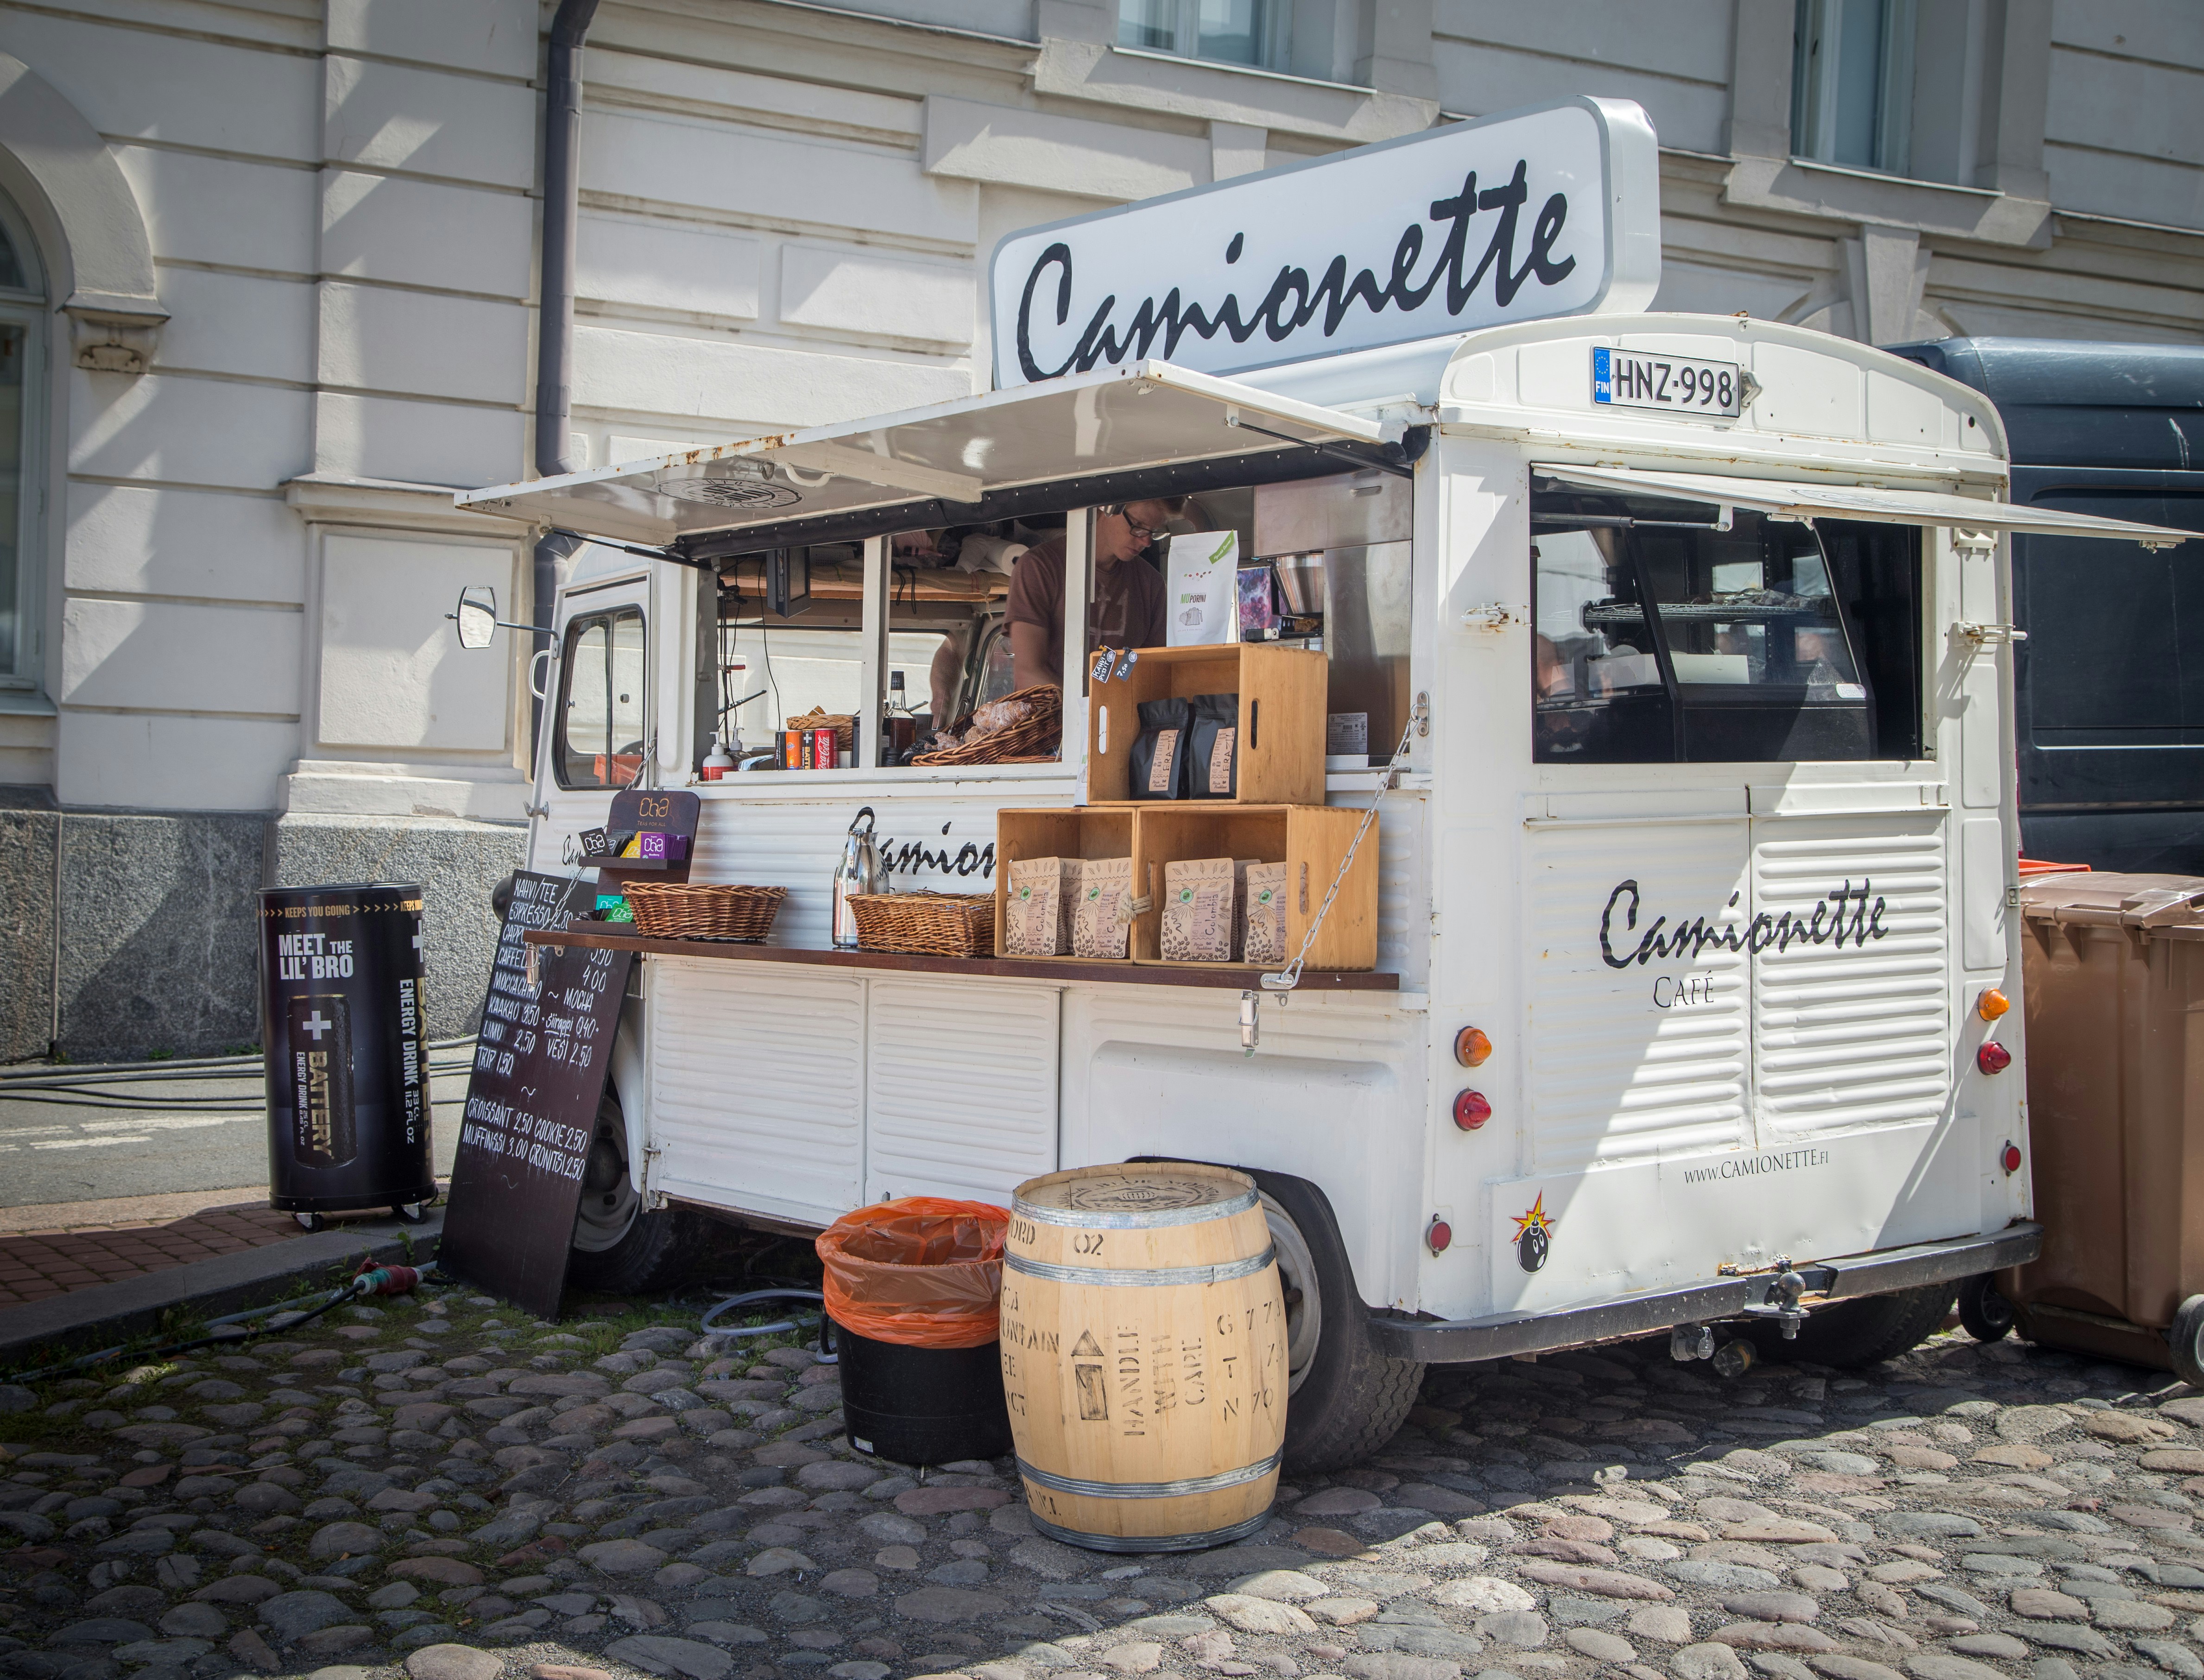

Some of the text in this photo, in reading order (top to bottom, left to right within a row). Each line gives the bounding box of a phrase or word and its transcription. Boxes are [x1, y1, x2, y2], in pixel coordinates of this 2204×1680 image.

[1017, 159, 1576, 383] Camionette
[1595, 381, 1610, 394] FIN
[1616, 357, 1732, 408] HNZ-998
[1163, 732, 1176, 771] BRAZIL
[1223, 731, 1234, 771] BRAZIL
[644, 838, 663, 852] Cha
[285, 905, 350, 918] KEEPS YOU GOING
[1036, 892, 1048, 931] Colombia
[1205, 894, 1218, 935] Colombia
[1600, 878, 1888, 969] Camionette
[278, 933, 353, 956] MEET THE
[311, 954, 354, 979] BRO
[488, 996, 519, 1020] KAAKAO
[563, 988, 594, 1013] MOCHA
[1653, 970, 1714, 1008] CAFÉ
[400, 979, 418, 1086] ENERGY DRINK
[483, 1020, 504, 1040] LIMU
[547, 1038, 569, 1061] VESI
[296, 1051, 308, 1109] ENERGY DRINK
[413, 1090, 419, 1105] 33
[309, 1051, 332, 1157] BATTERY
[406, 1111, 414, 1126] FL
[467, 1097, 514, 1128] CROISSANT
[534, 1118, 567, 1147] COOKIE
[407, 1128, 415, 1144] OZ
[1217, 1314, 1233, 1335] G
[1117, 1325, 1145, 1436] HANDLE
[1181, 1337, 1205, 1405] CARE
[1223, 1356, 1237, 1378] T
[1224, 1397, 1239, 1426] N
